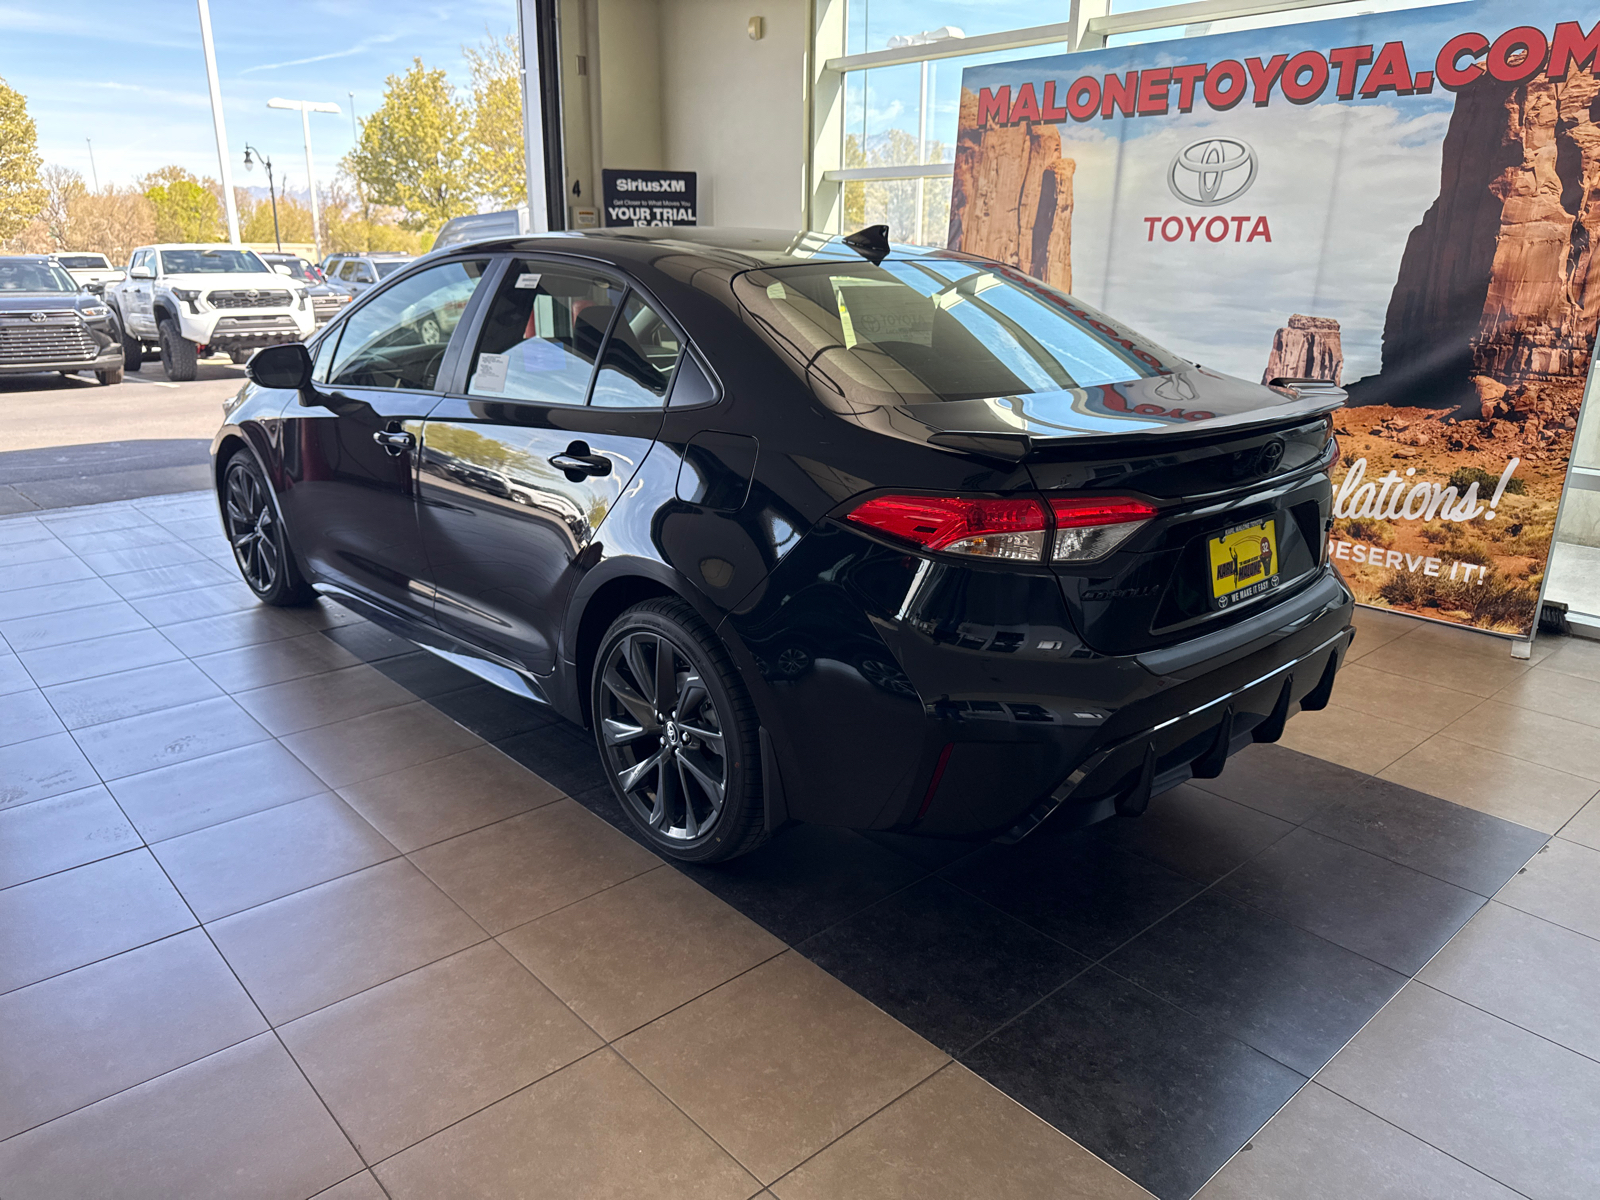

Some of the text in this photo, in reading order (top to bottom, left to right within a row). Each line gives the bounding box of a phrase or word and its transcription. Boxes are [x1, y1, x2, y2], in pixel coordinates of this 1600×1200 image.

[977, 20, 1600, 128] MALONETOYOTA.COM
[572, 179, 581, 198] 4
[616, 179, 685, 192] SiriusXM
[624, 199, 641, 207] Closer
[648, 200, 662, 208] What
[662, 200, 680, 208] Moves
[608, 207, 650, 220] YOUR
[653, 208, 696, 221] TRIAL
[1143, 215, 1273, 243] TOYOTA
[1262, 542, 1268, 552] 32
[1449, 561, 1487, 586] IT!
[1231, 581, 1268, 602] WE MAKE IT EASY
